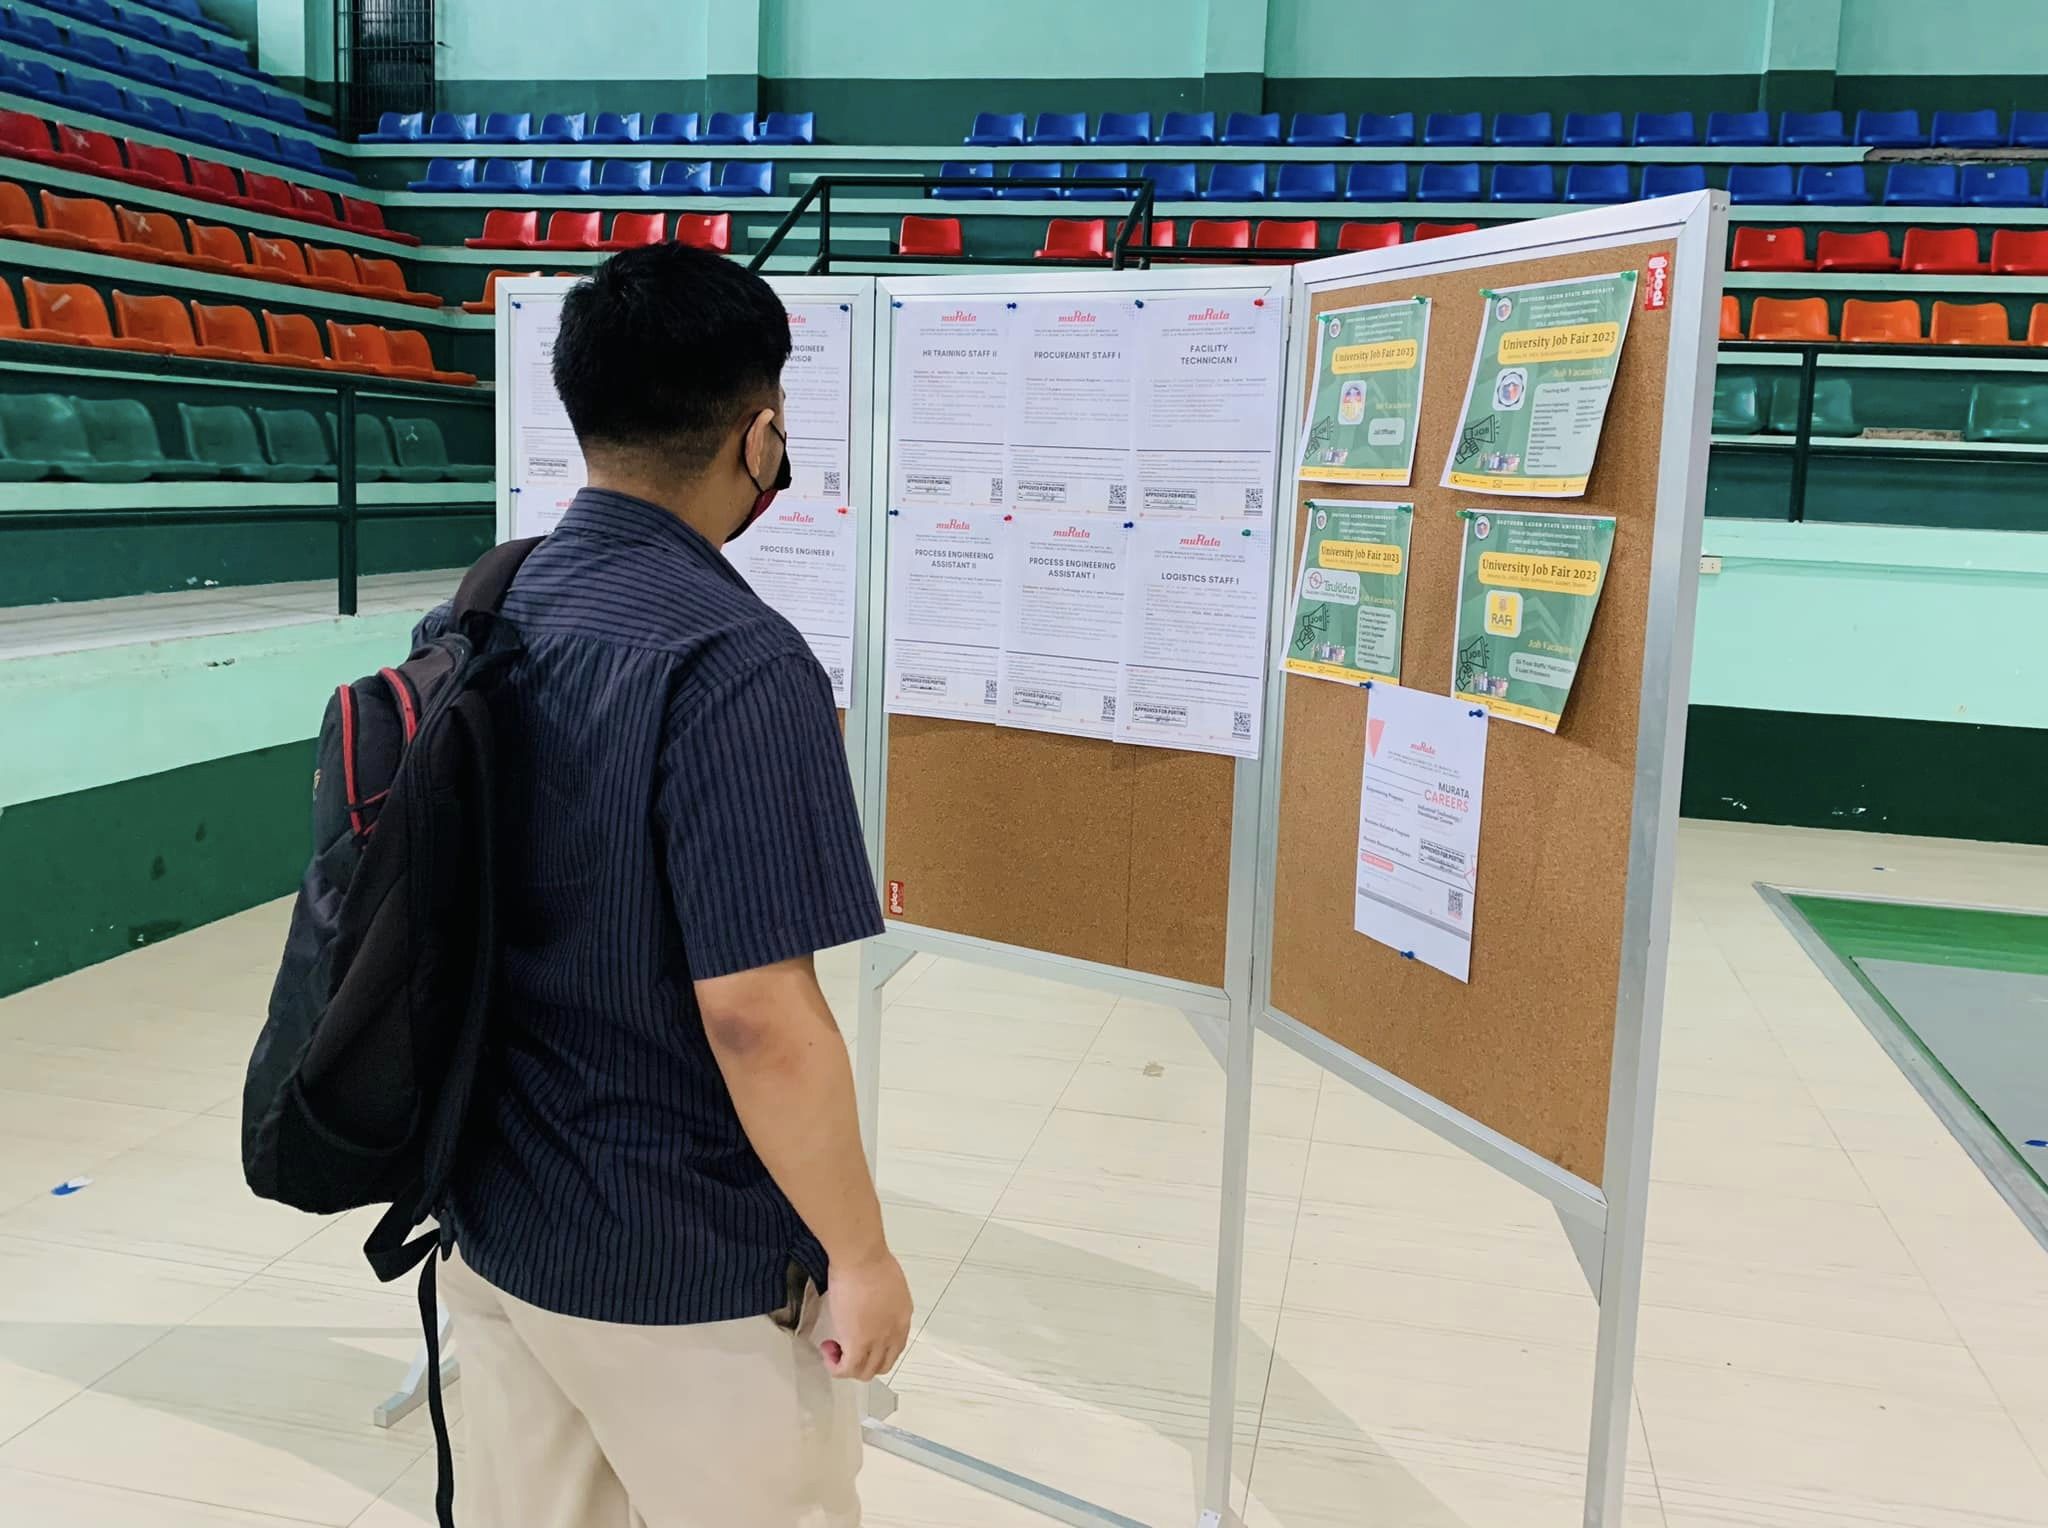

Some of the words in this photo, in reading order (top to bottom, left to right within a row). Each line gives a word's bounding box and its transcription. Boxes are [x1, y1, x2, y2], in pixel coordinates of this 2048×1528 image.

[1187, 308, 1230, 320] muRata
[1503, 336, 1550, 350] University
[1552, 333, 1568, 348] Job
[1570, 332, 1589, 345] Fair
[1592, 331, 1616, 343] 2023
[934, 350, 966, 358] TRAINING
[968, 350, 990, 358] STAFF
[1190, 344, 1228, 353] FACILITY
[1034, 351, 1090, 359] PROCUREMENT
[1092, 351, 1115, 359] STAFF
[1180, 356, 1232, 365] TECHNICIAN
[1474, 427, 1489, 436] JOB
[760, 545, 794, 555] PROCESS
[796, 548, 830, 556] ENGINEER
[915, 549, 946, 558] PROCESS
[948, 551, 994, 560] ENGINEERING
[1355, 549, 1366, 560] Job
[1367, 550, 1381, 560] Fair
[1383, 553, 1400, 564] 2023
[931, 560, 971, 569] ASSISTANT
[1029, 556, 1064, 567] PROCESS
[1066, 560, 1116, 570] ENGINEERING
[1048, 570, 1090, 579] ASSISTANT
[1482, 559, 1530, 576] University
[1532, 563, 1548, 576] Job
[1551, 565, 1570, 579] Fair
[1573, 569, 1597, 582] 2023
[1161, 572, 1206, 583] LOGISTICS
[1208, 575, 1234, 584] STAFF
[1438, 782, 1470, 799] MURATA
[1424, 789, 1469, 813] CAREERS
